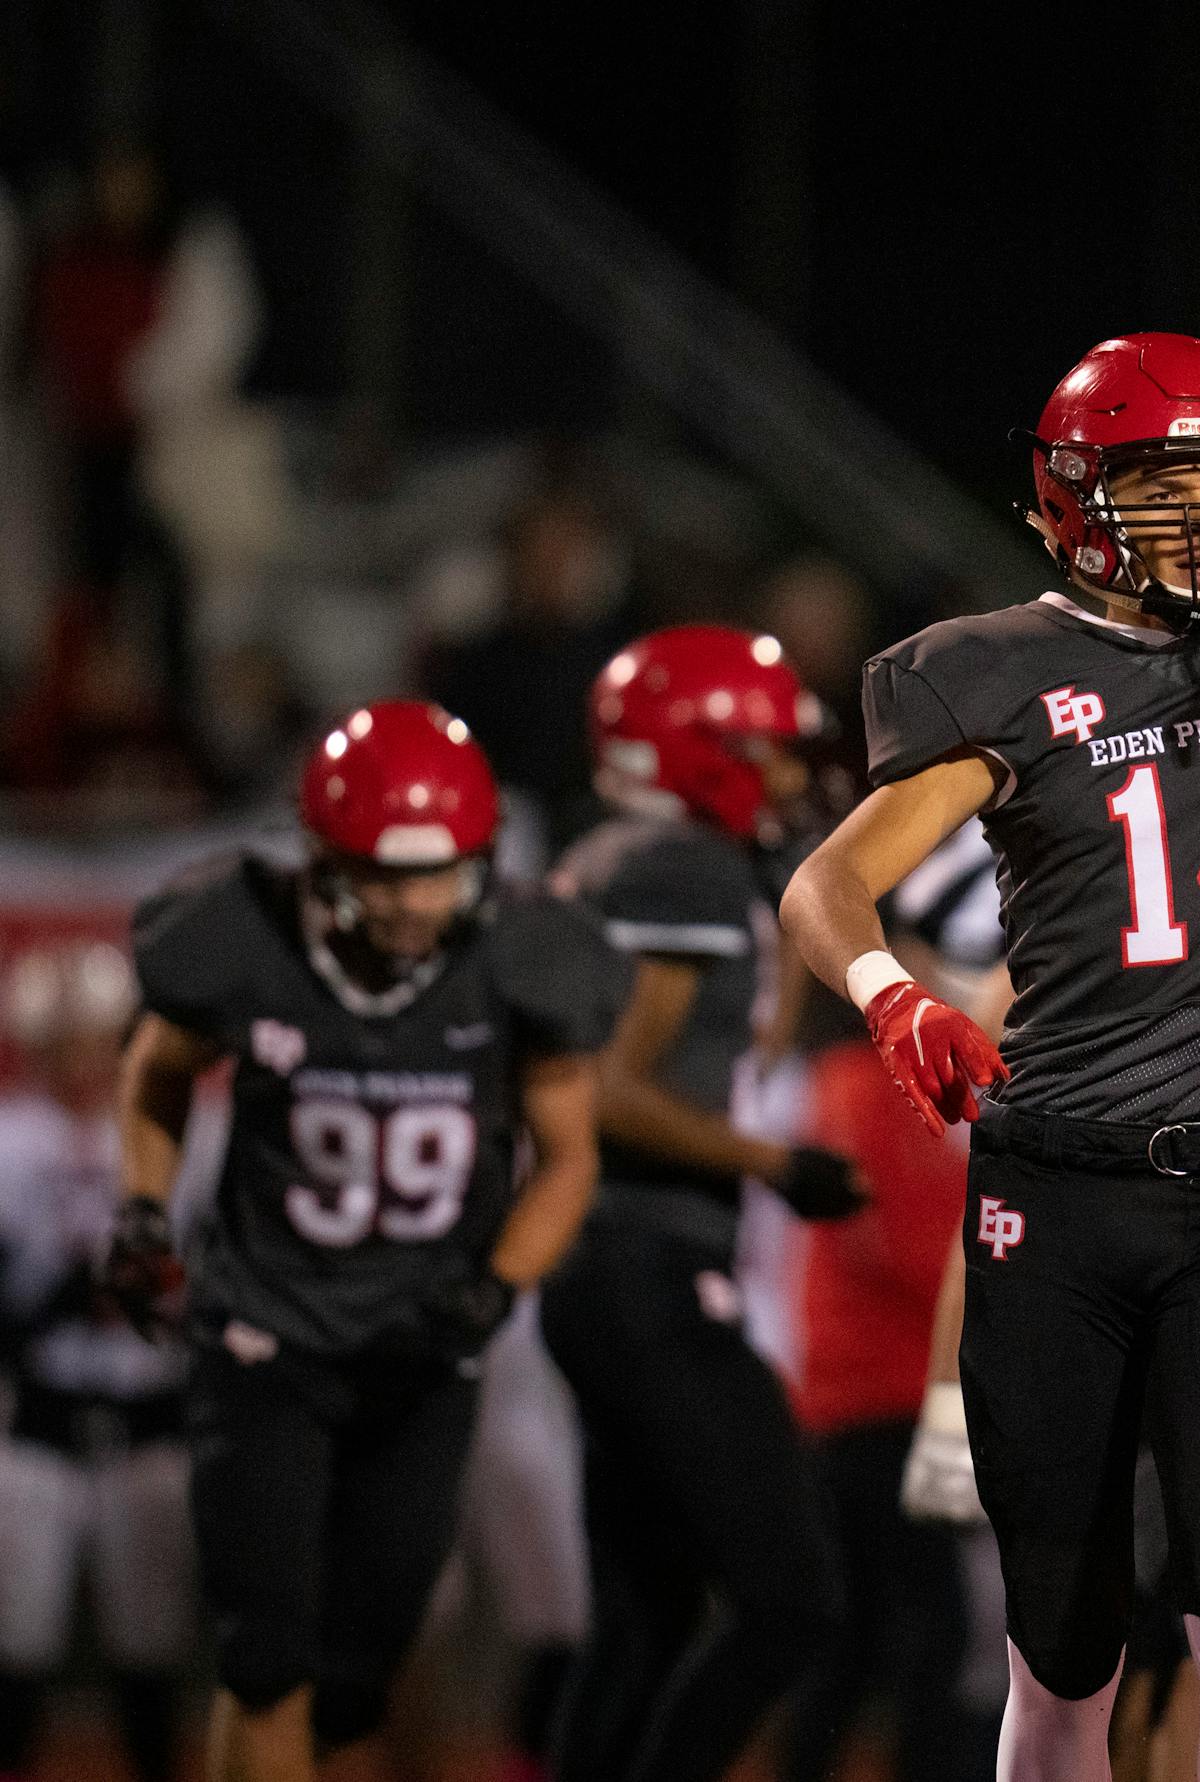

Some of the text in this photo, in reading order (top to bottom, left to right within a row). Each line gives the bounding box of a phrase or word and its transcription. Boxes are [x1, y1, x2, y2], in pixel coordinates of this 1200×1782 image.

[1040, 684, 1106, 745] EP
[1088, 726, 1166, 767] EDEN
[286, 1101, 476, 1247] 99
[977, 1194, 1026, 1262] EP
